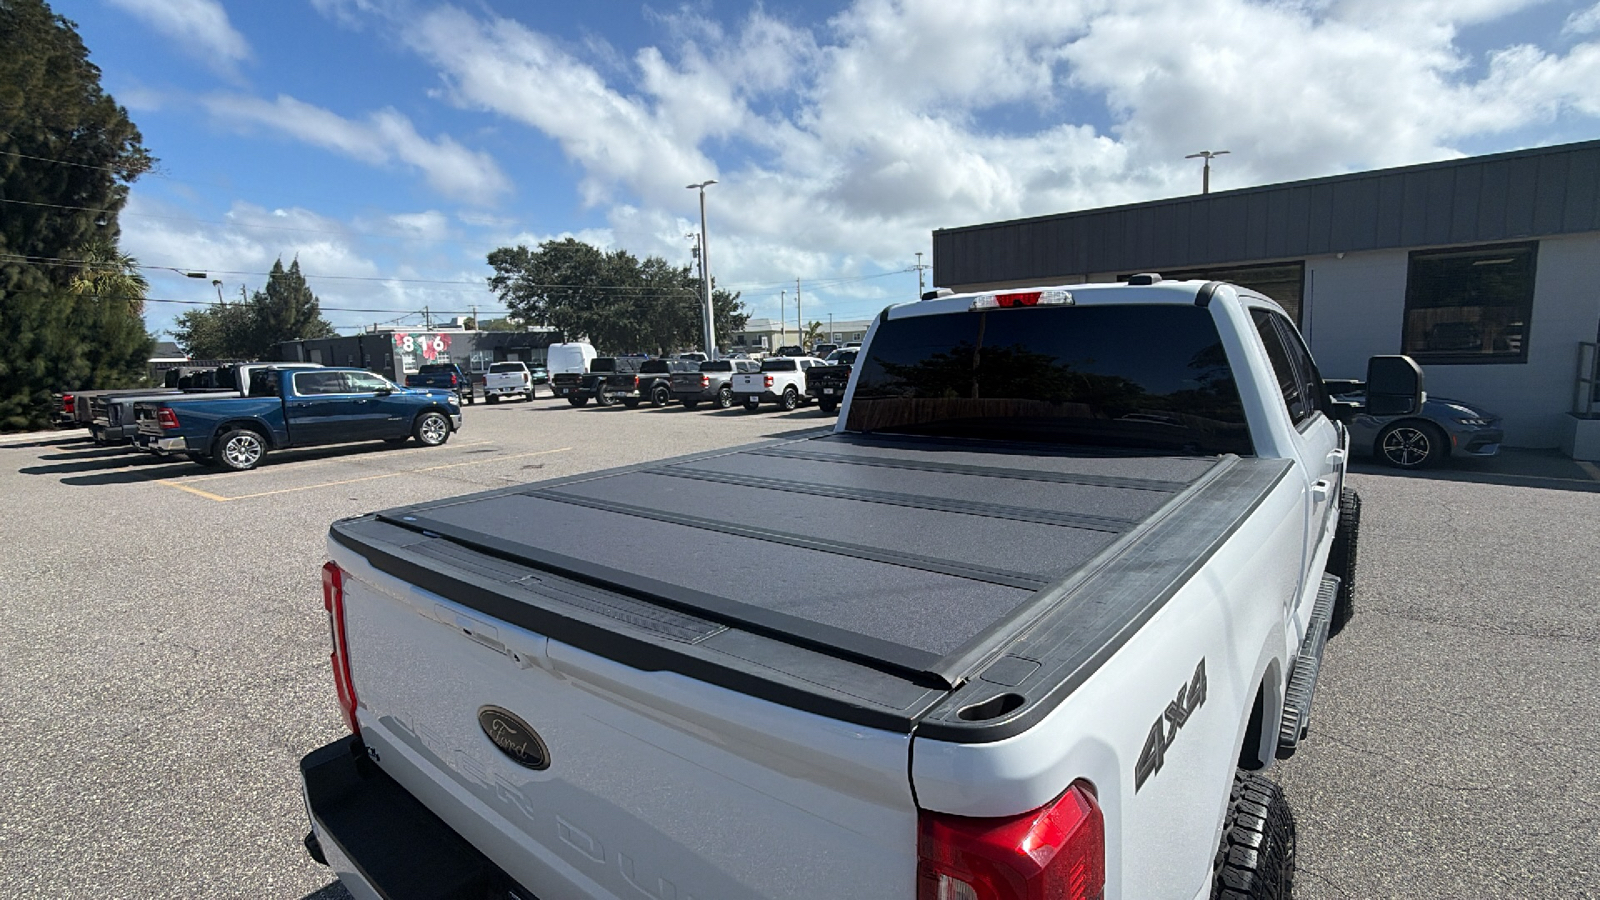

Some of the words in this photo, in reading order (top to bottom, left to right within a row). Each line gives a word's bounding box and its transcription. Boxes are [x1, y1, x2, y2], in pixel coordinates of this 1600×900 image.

[402, 335, 444, 352] 816
[489, 718, 528, 759] Ford
[555, 812, 697, 900] DU
